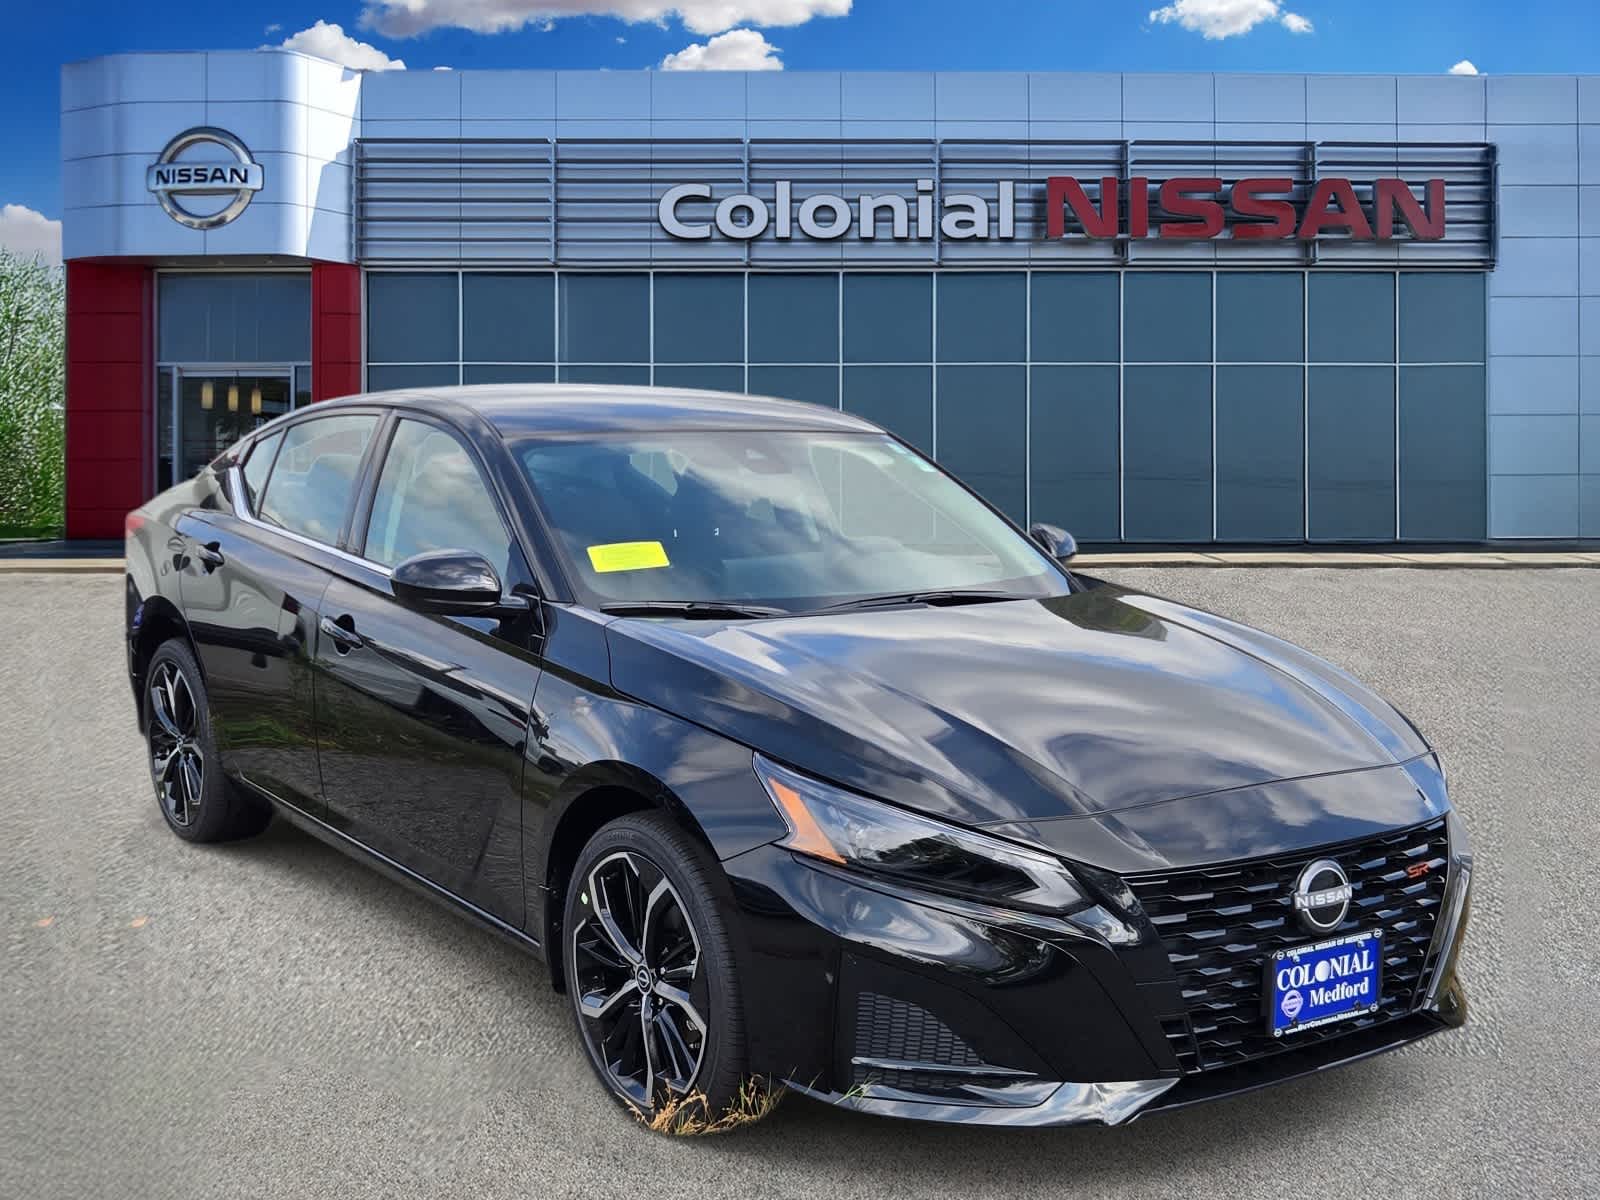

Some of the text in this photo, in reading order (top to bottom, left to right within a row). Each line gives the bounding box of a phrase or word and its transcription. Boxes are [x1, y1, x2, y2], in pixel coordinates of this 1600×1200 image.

[155, 167, 249, 185] NISSAN
[657, 176, 1446, 241] Colonial NISSAN
[1407, 862, 1429, 879] SR
[1296, 885, 1353, 908] NISSAN
[1277, 949, 1374, 991] COLONIAL
[1309, 976, 1369, 1008] Medford
